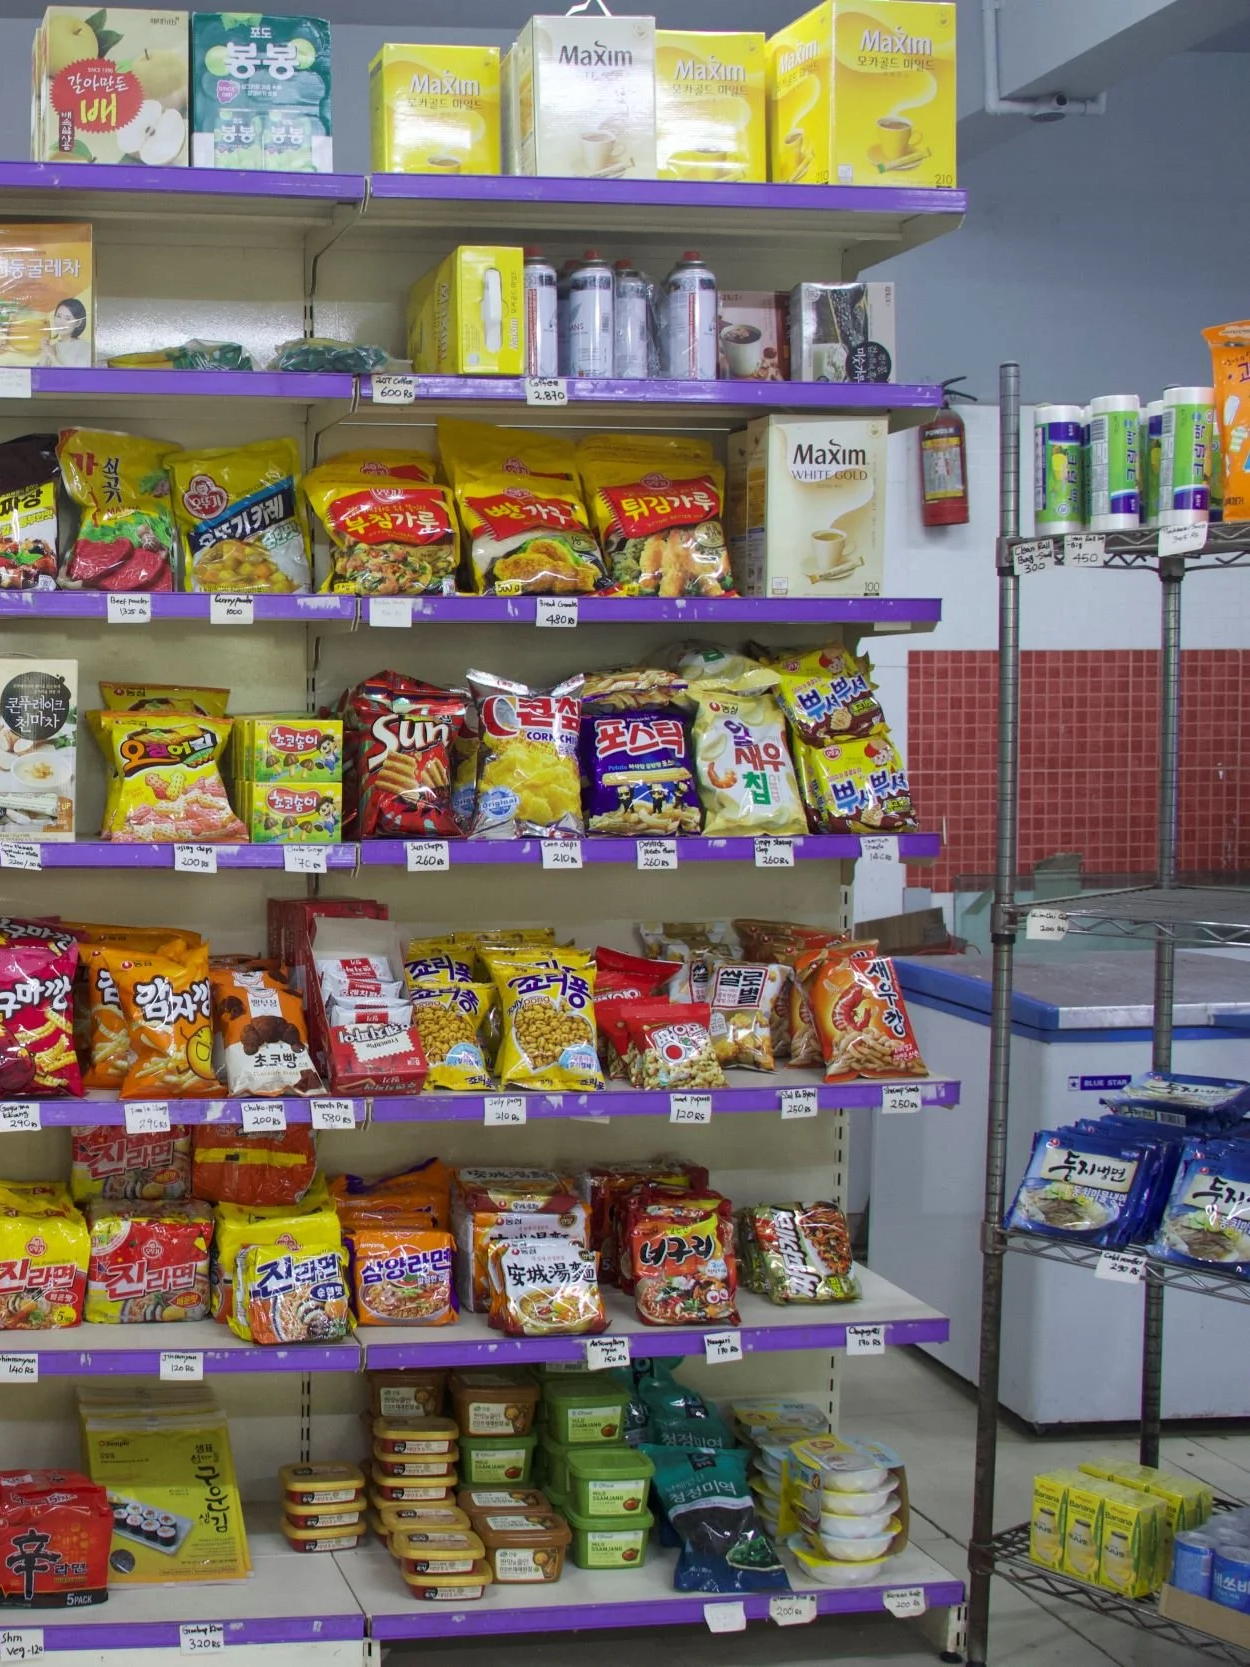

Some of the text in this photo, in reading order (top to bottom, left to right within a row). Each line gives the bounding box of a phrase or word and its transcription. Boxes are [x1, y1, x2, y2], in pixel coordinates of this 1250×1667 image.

[250, 28, 272, 39] 포도
[860, 27, 933, 56] Maxim
[226, 43, 299, 80] 봉봉
[558, 40, 633, 67] Maxim
[779, 40, 819, 75] Maxim
[857, 56, 935, 72] 모카골드 마일드
[674, 56, 746, 82] Maxim
[67, 72, 129, 94] 갈아만든
[410, 71, 480, 96] Maxim
[80, 95, 118, 127] 배
[934, 174, 953, 186] 210
[508, 317, 519, 350] Maxim
[380, 387, 413, 398] 600 Rs
[792, 439, 867, 465] Maxim
[791, 470, 867, 481] WHITE GOLD
[0, 489, 44, 518] 짜장
[191, 496, 222, 510] 오뚜기
[484, 501, 575, 523] 빵가루
[622, 490, 716, 522] 튀김가루
[198, 495, 285, 549] 오뚜기 카레
[345, 511, 441, 535] 부침가루
[1024, 562, 1046, 573] 300
[1072, 553, 1098, 563] 450
[864, 582, 880, 592] 100
[110, 596, 127, 604] Beef
[545, 614, 567, 625] 480
[5, 696, 65, 714] 콘푸레이크
[15, 710, 60, 733] 천마차
[268, 729, 319, 752] 초코송이
[368, 713, 450, 772] Sun
[526, 731, 553, 742] CORN
[595, 719, 685, 758] 포스틱
[727, 720, 751, 746] 알
[120, 733, 218, 778] 오징어집
[735, 743, 782, 772] 새우
[742, 770, 772, 806] 칩
[267, 792, 317, 812] 초코송이
[481, 797, 518, 810] Original
[410, 843, 424, 851] Sun
[552, 853, 570, 862] 210
[181, 857, 200, 867] 200
[415, 855, 436, 866] 260
[643, 857, 661, 867] 260
[762, 856, 779, 865] 260
[508, 972, 592, 1009] 죠리퐁
[866, 957, 908, 1039] 새우깡
[254, 1053, 298, 1069] 초코빵
[10, 1118, 31, 1128] 290
[252, 1116, 272, 1126] 200
[495, 1112, 509, 1121] 210
[676, 1108, 693, 1120] 120
[89, 1139, 174, 1179] 진라면
[1049, 1150, 1126, 1183] 둥지냉면
[641, 1233, 716, 1268] 너구리
[773, 1207, 821, 1299] 짜파게티
[255, 1254, 338, 1299] 진라면
[361, 1248, 450, 1286] 삼양라면
[507, 1261, 597, 1287] 安城湯麵
[107, 1260, 197, 1301] 진라면
[57, 1311, 64, 1321] 5
[171, 1364, 184, 1372] 120
[195, 1444, 213, 1453] 샘표
[670, 1480, 737, 1504] 청정미역
[1034, 1489, 1060, 1503] Banana
[1069, 1500, 1096, 1514] Banana
[1105, 1512, 1133, 1526] Banana
[5, 1527, 63, 1601] 辛
[53, 1563, 88, 1576] 라면
[66, 1593, 93, 1607] 5PACK
[189, 1639, 211, 1649] 320
